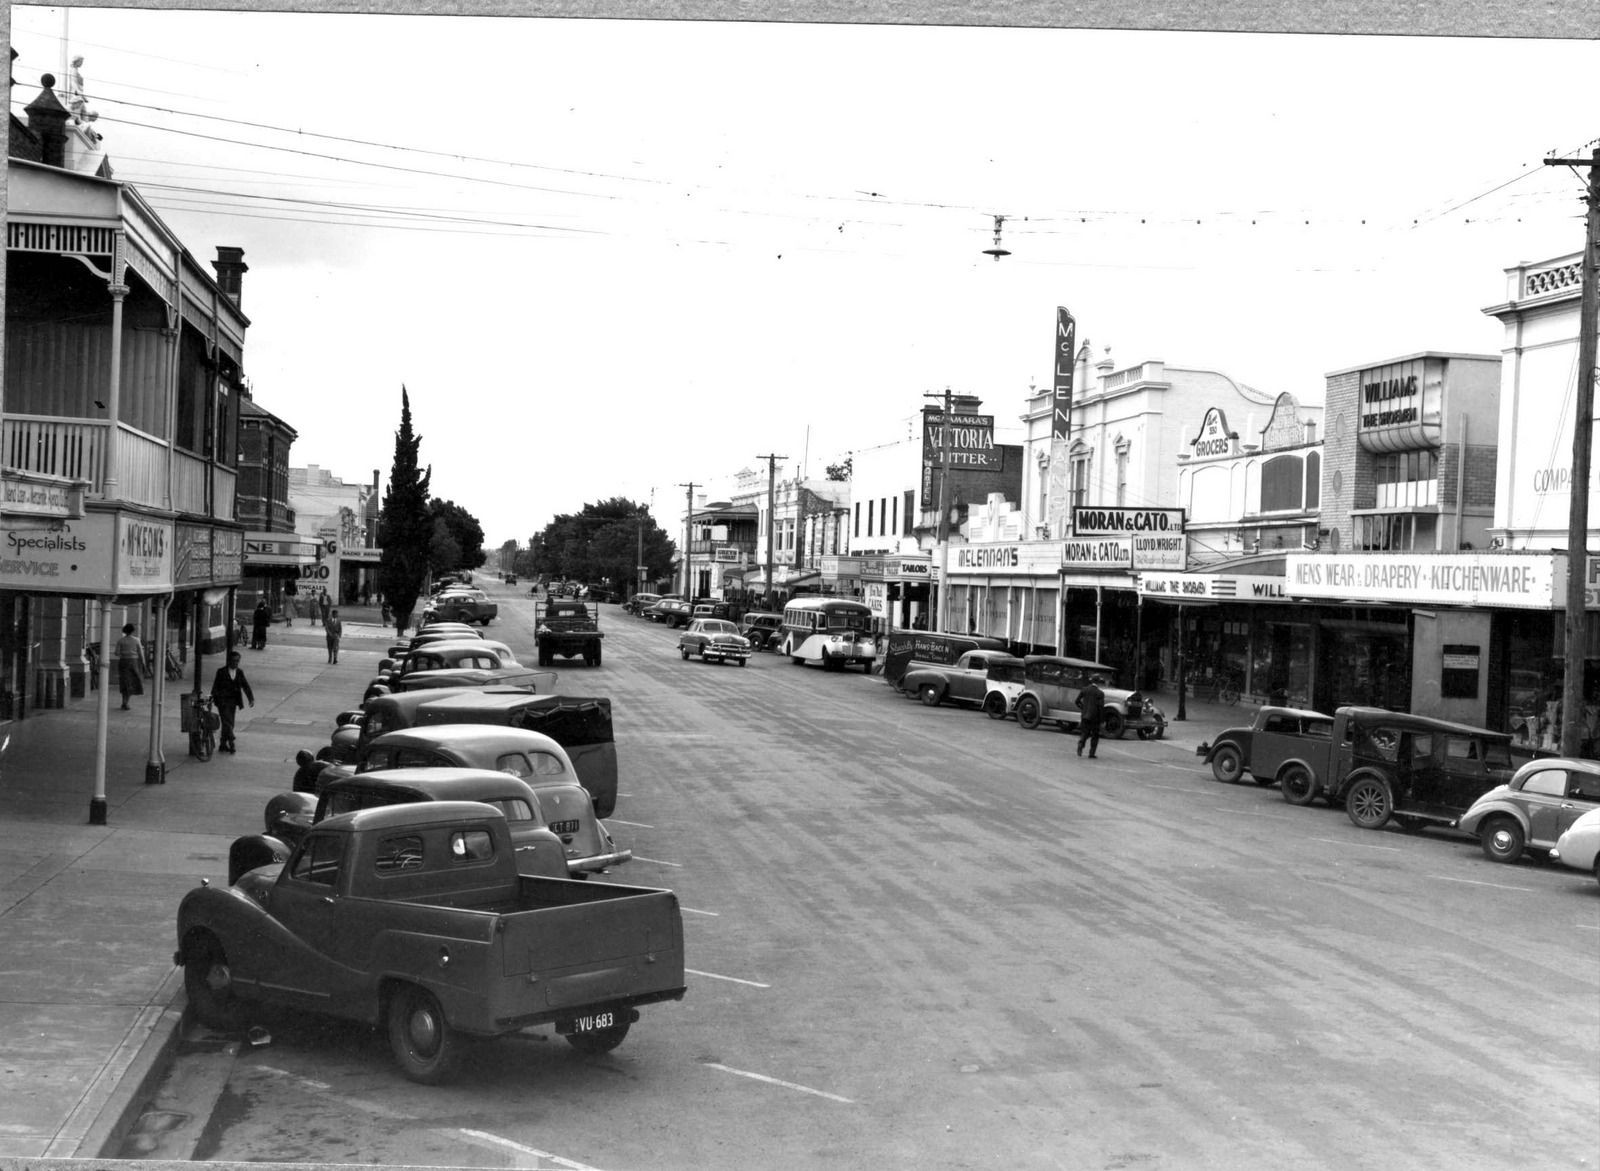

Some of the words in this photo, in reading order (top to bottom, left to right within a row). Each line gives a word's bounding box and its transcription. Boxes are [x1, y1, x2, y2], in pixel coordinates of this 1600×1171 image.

[1364, 376, 1418, 403] WILLIAMS
[928, 427, 994, 449] VITORIA
[1196, 439, 1229, 457] GROCERS
[1078, 511, 1124, 530] MORAN
[8, 532, 86, 555] Specialists
[1065, 543, 1091, 560] MORAN
[902, 564, 928, 573] TAILORS
[1326, 564, 1354, 587] WEAR
[1364, 565, 1421, 589] DRAPERY
[1431, 566, 1531, 593] KITCHENWARE
